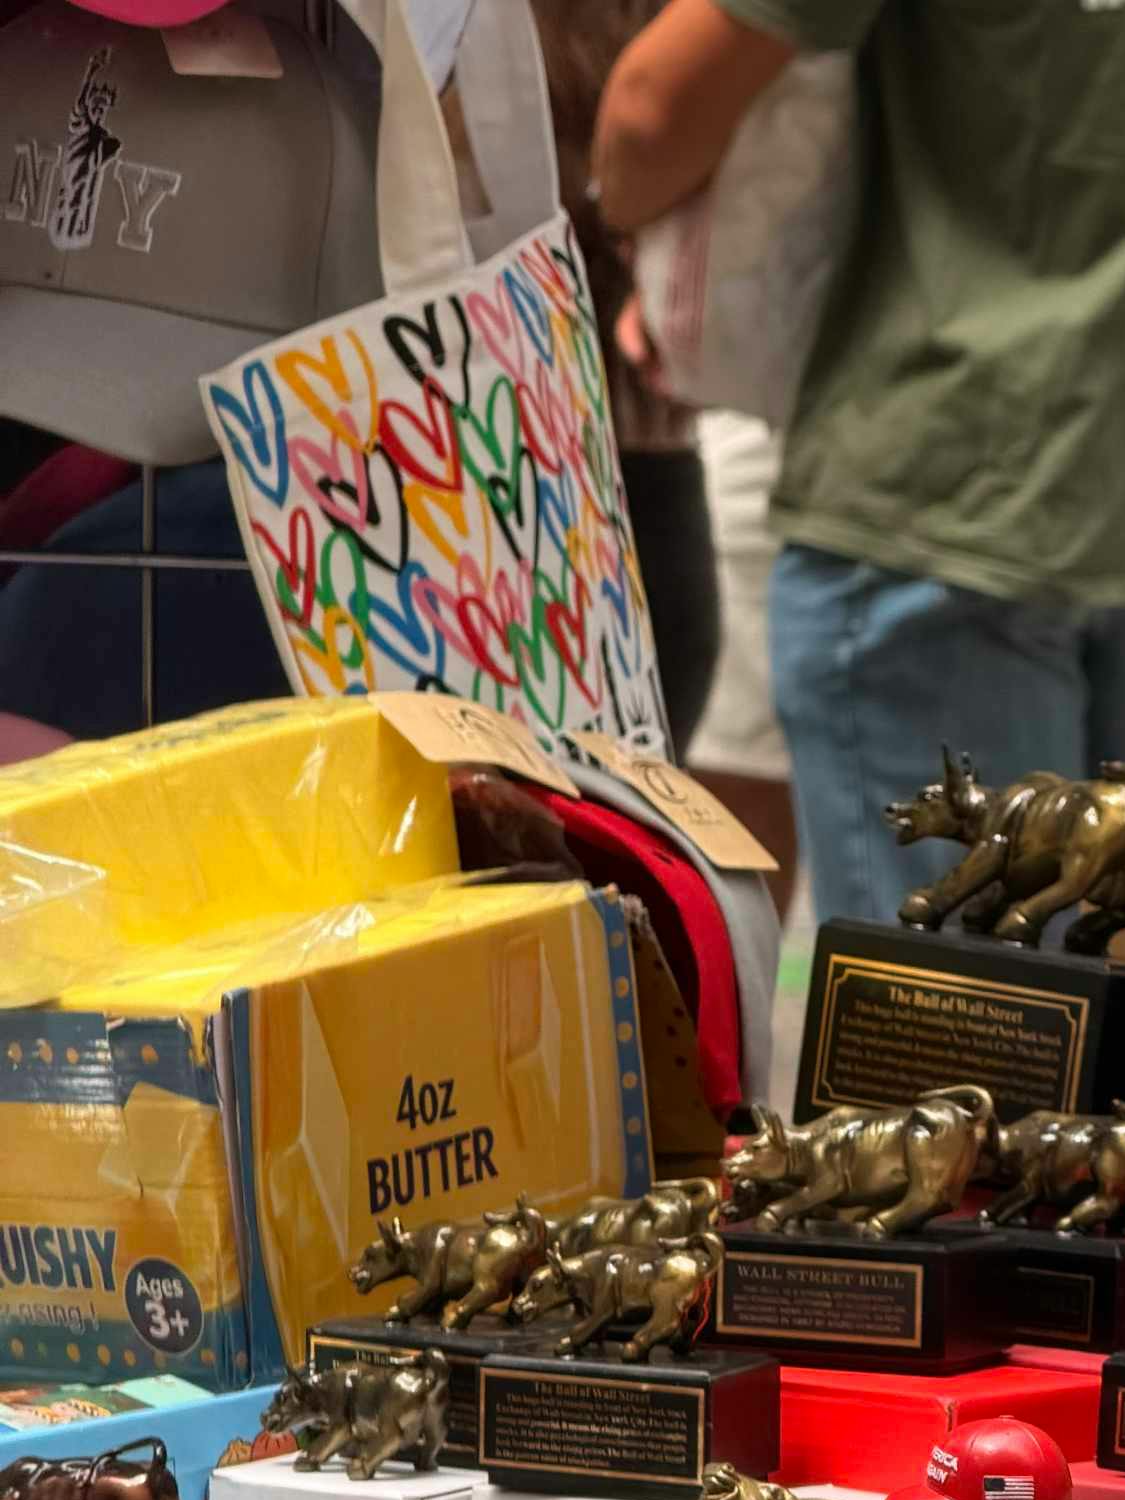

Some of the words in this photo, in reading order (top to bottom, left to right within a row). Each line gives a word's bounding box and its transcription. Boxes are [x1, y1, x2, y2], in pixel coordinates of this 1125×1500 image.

[367, 1125, 499, 1216] BUTTER
[135, 1271, 185, 1303] Ages
[737, 1264, 783, 1281] WALL
[785, 1268, 854, 1287] STREET
[858, 1273, 906, 1290] BULL
[145, 1300, 191, 1339] 3+
